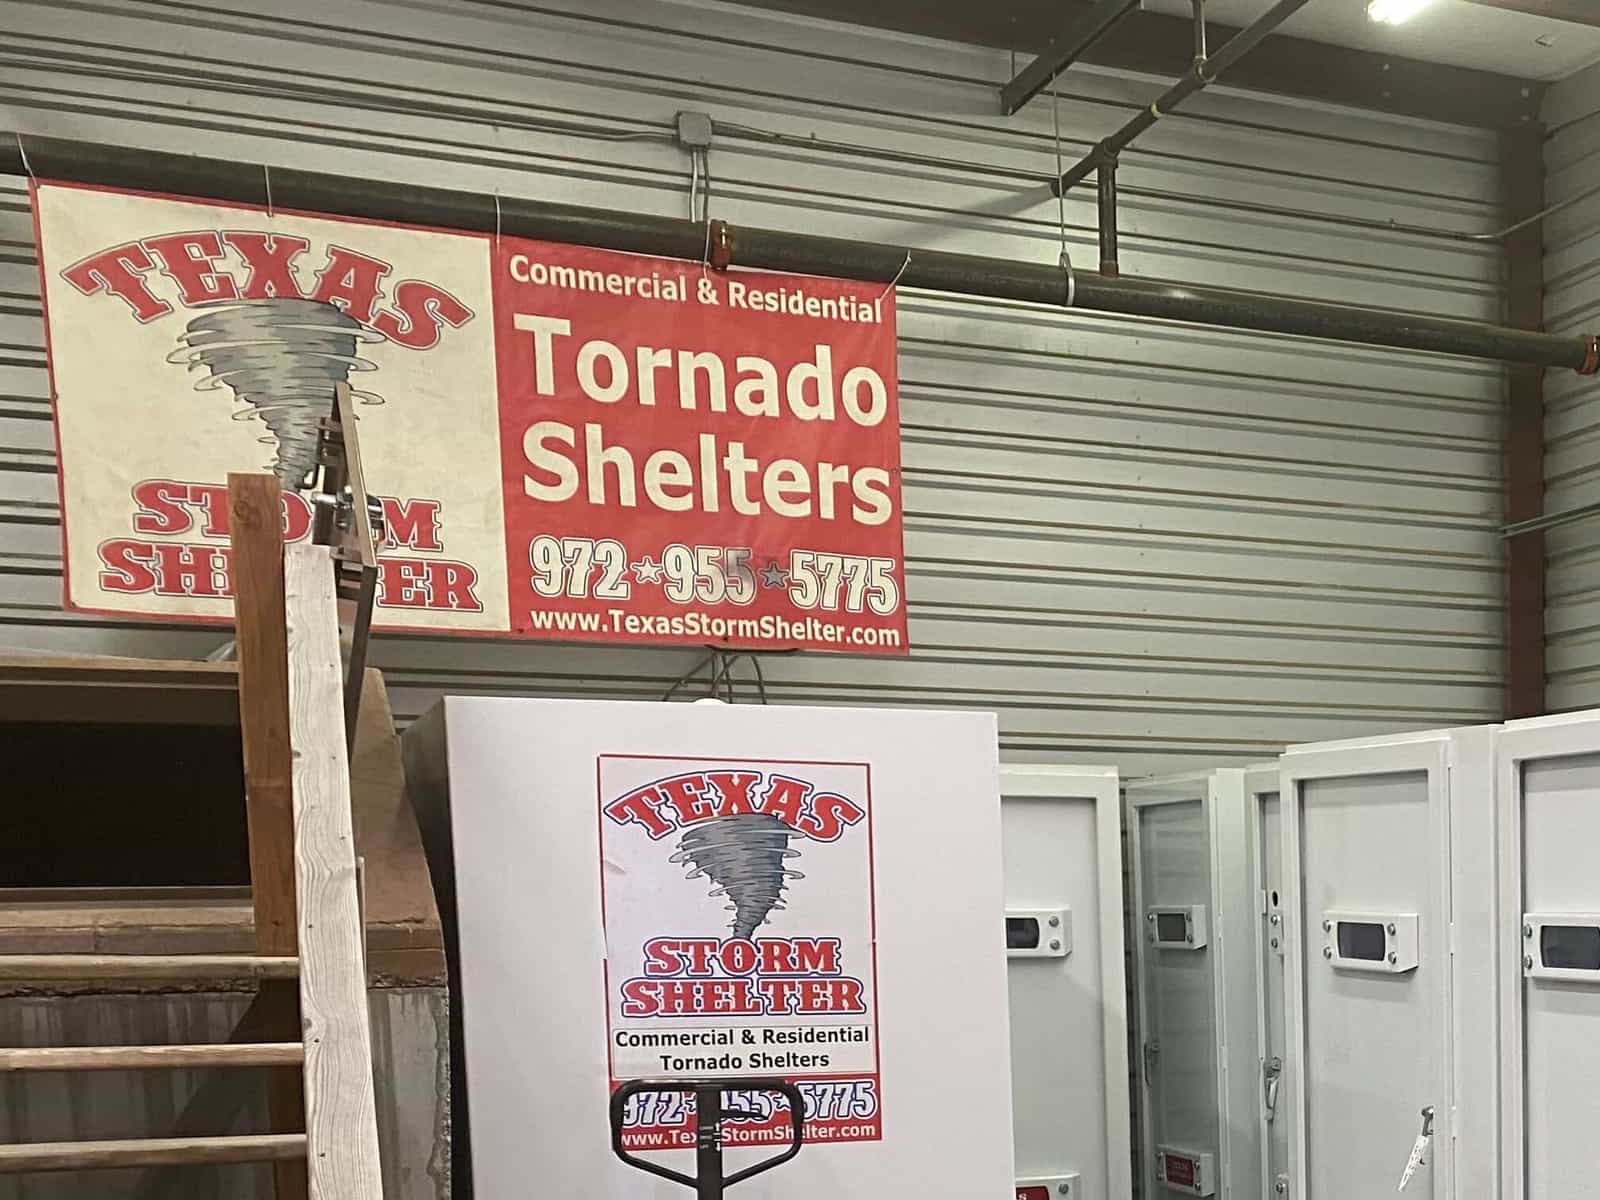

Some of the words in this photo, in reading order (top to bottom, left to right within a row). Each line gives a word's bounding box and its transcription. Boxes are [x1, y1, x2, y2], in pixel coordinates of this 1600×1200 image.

[61, 229, 476, 351] TEXAS
[509, 255, 687, 302] Commercial
[697, 278, 720, 306] &
[728, 281, 882, 324] Residential
[513, 312, 888, 428] Tornado
[522, 420, 893, 526] Shelters
[97, 537, 483, 613] SHER
[529, 534, 631, 600] 972
[661, 543, 757, 606] 955
[788, 550, 899, 616] 5775
[530, 608, 901, 648] www.TexasStormShelter.com
[604, 769, 866, 843] TEXAS
[643, 937, 841, 977] STORM
[621, 977, 867, 1017] SHELTER
[615, 1029, 734, 1048] Commercial
[741, 1028, 756, 1045] &
[763, 1026, 870, 1045] Residential
[660, 1052, 743, 1071] Tornado
[749, 1050, 830, 1069] Shelters
